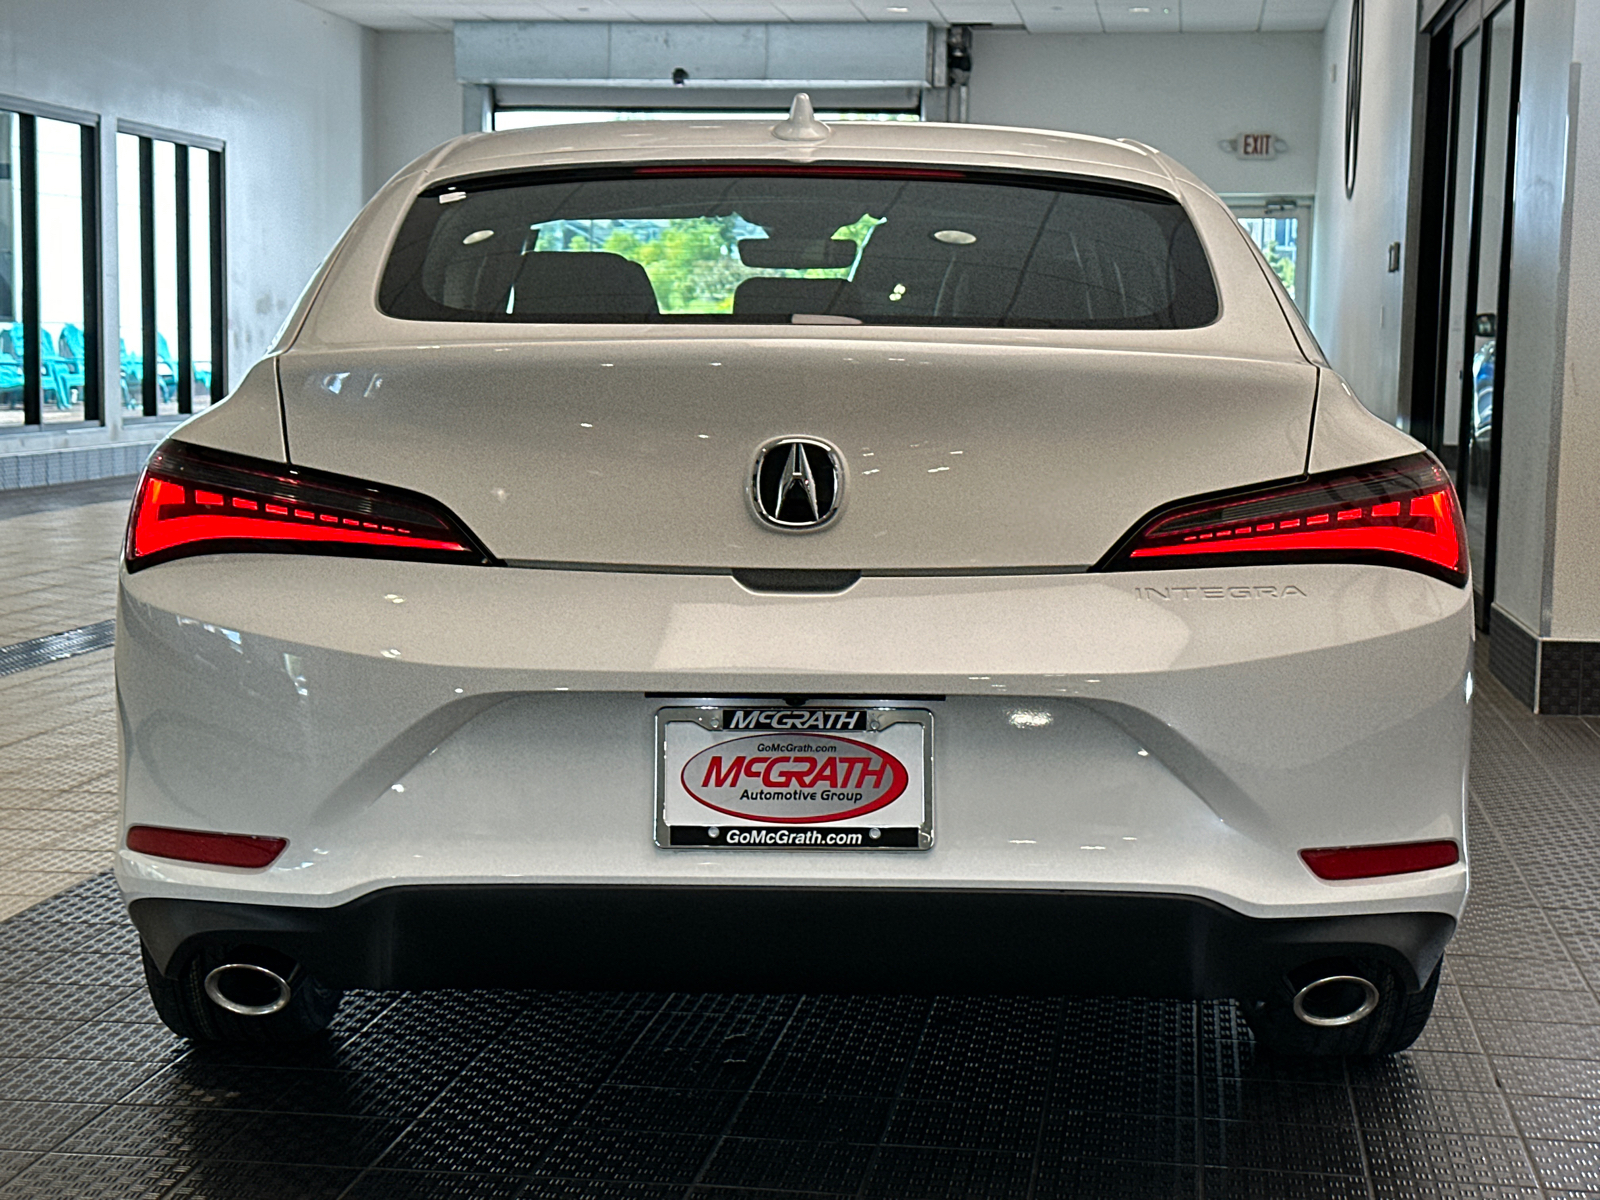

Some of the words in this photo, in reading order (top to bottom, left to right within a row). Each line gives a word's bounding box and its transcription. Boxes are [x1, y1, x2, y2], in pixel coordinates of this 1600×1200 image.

[1243, 134, 1271, 155] EXIT
[1135, 585, 1307, 601] INTEGRA
[757, 743, 837, 754] GoMcGrath.com
[740, 790, 817, 802] Automotive
[820, 790, 863, 804] Group
[726, 830, 862, 845] GoMcGrath.com
